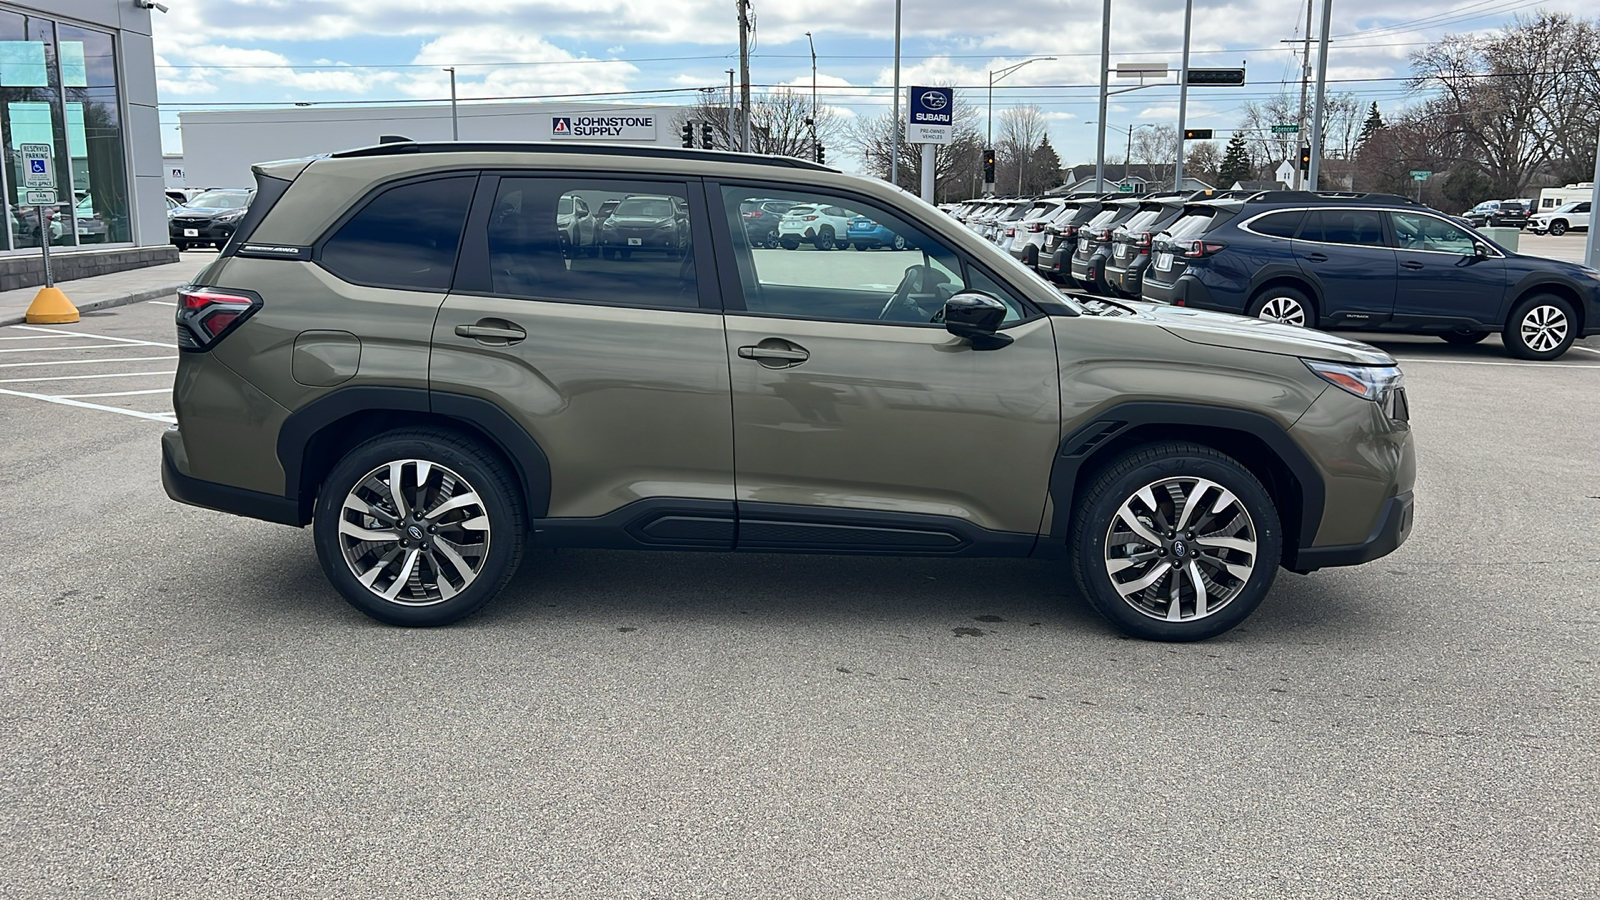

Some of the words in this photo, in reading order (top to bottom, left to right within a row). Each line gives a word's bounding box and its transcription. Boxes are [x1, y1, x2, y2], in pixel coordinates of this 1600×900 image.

[574, 117, 652, 126] JOHNSTONE
[916, 112, 950, 122] SUBARU
[574, 127, 622, 136] SUPPLY
